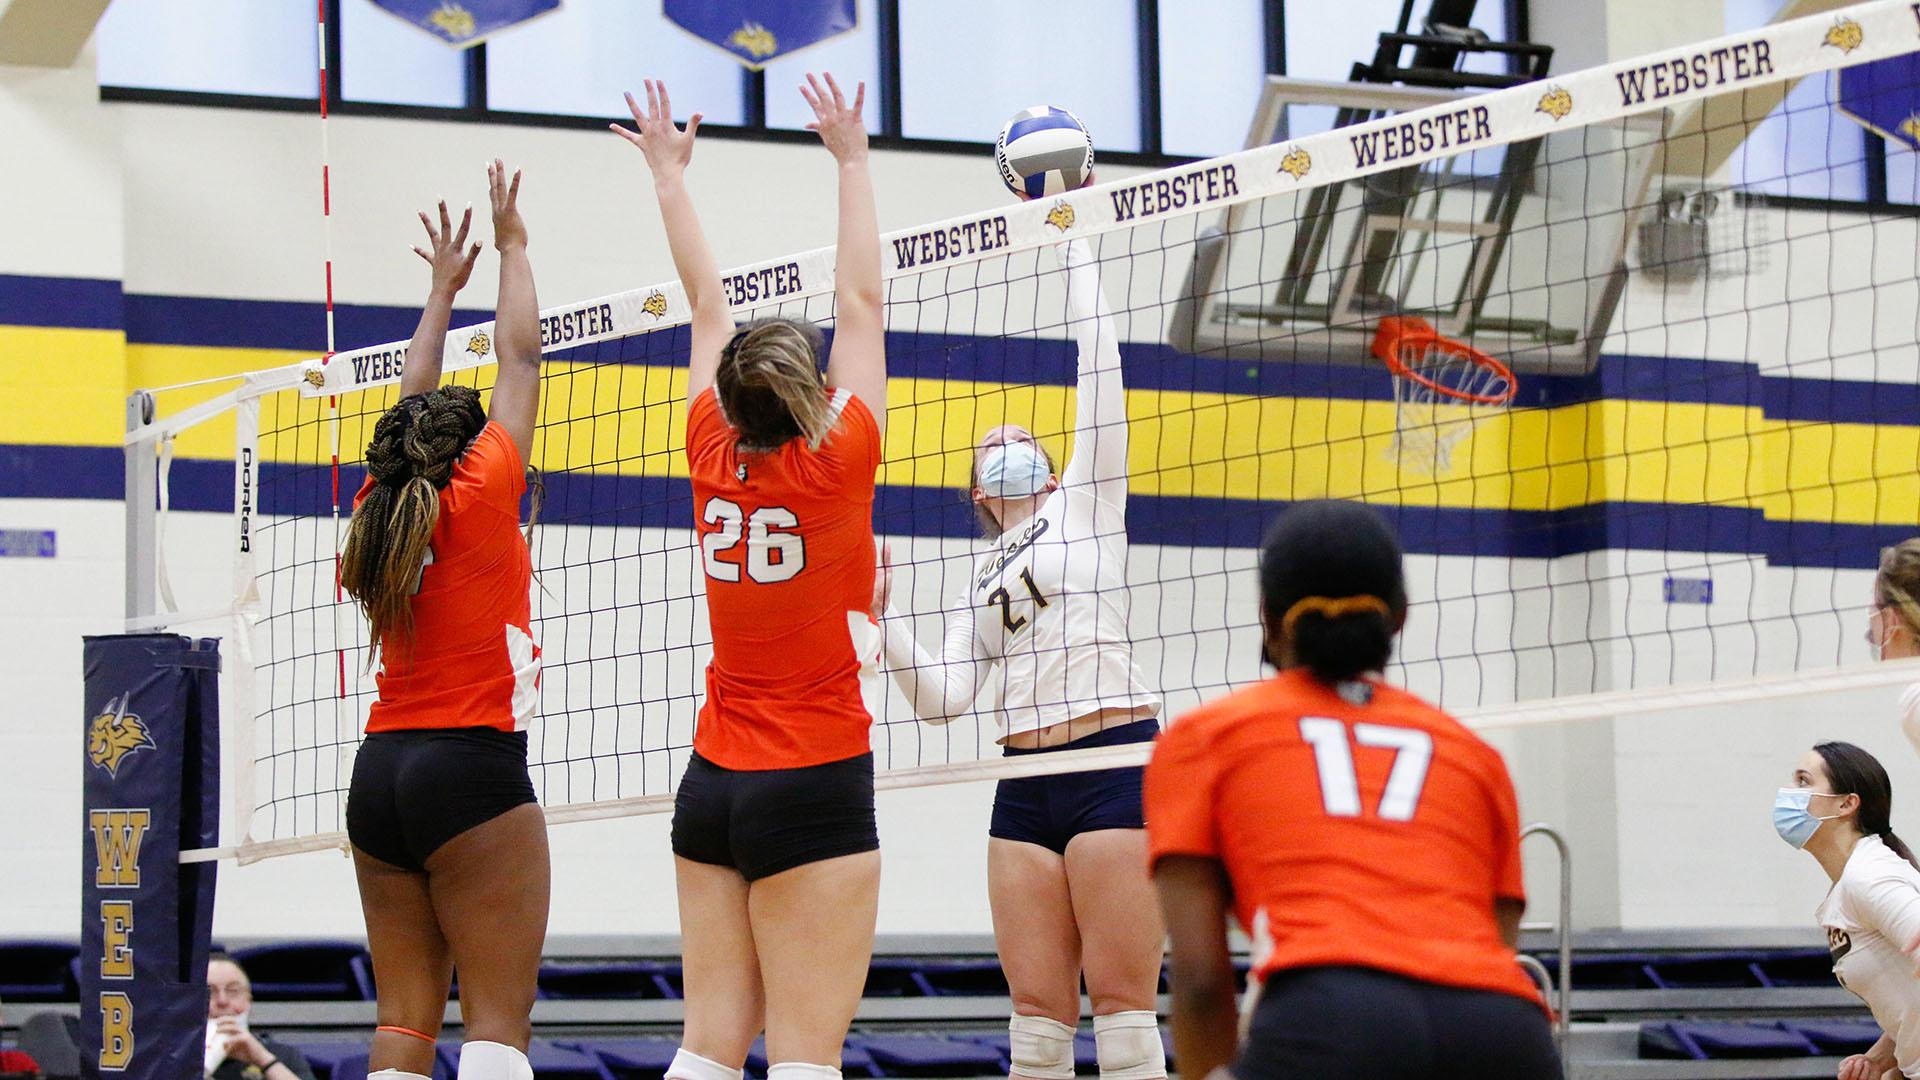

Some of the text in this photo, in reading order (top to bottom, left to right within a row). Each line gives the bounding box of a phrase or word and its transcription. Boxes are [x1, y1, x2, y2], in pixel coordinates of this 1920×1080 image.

[1616, 39, 1774, 107] WEBSTER
[1350, 105, 1492, 168] WEBSTER
[1110, 163, 1239, 222] WEBSTER
[892, 215, 1009, 270] WEBSTER
[721, 262, 803, 307] EBSTER
[540, 303, 614, 347] EBSTER
[351, 348, 408, 385] WEBS
[702, 495, 806, 584] 26
[988, 566, 1048, 634] 21
[1299, 716, 1433, 822] 17
[89, 807, 151, 1072] WEB
